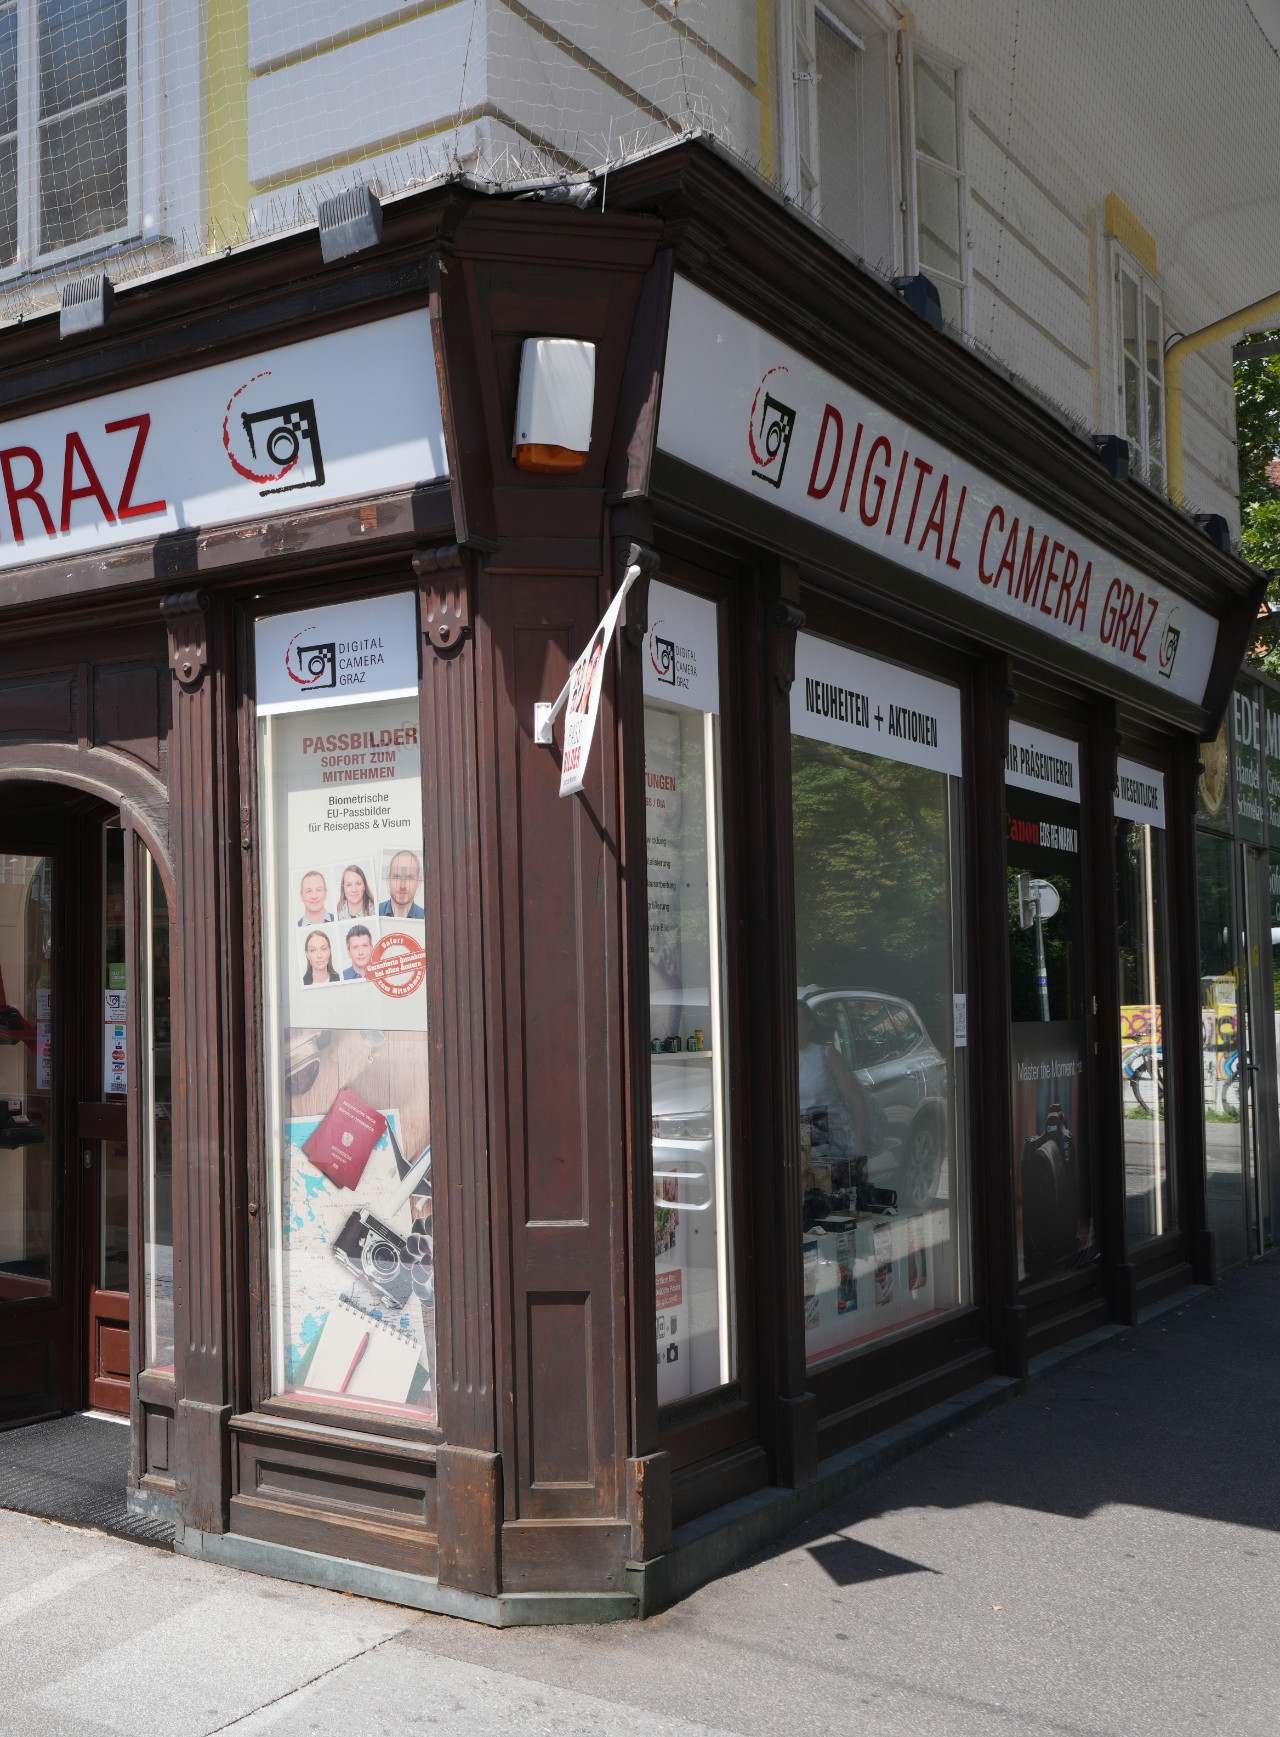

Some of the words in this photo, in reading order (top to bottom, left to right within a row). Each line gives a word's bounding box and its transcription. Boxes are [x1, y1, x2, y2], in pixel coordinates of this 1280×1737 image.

[806, 403, 968, 570] DIGITAL
[978, 505, 1093, 632] CAMERA
[1099, 577, 1159, 662] GRAZ
[338, 637, 384, 654] DIGITAL
[676, 646, 696, 661] DIGITAL
[339, 653, 385, 670] CAMERA
[676, 661, 697, 677] CAMERA
[339, 672, 366, 686] GRAZ
[677, 676, 689, 689] GRAZ
[806, 677, 869, 728] NEUHEITEN
[889, 704, 938, 748] AKTIONEN
[302, 727, 418, 754] PASSBILDER
[321, 752, 365, 768] SOFORT
[369, 750, 396, 764] ZUM
[1020, 743, 1073, 789] PRÄSENTIEREN
[322, 766, 395, 783] MITNEHMEN
[328, 793, 389, 806] Biometrische
[1121, 776, 1158, 810] WESENTLICHE
[657, 799, 666, 808] DIA
[327, 806, 391, 820] EU-Passbilder
[308, 821, 322, 833] für
[323, 820, 370, 833] Reisepass
[372, 819, 380, 829] &
[381, 817, 411, 829] Visum
[1058, 826, 1073, 852] MARK
[1017, 1063, 1039, 1080] Master
[1040, 1062, 1051, 1079] the
[1051, 1060, 1075, 1078] Moment
